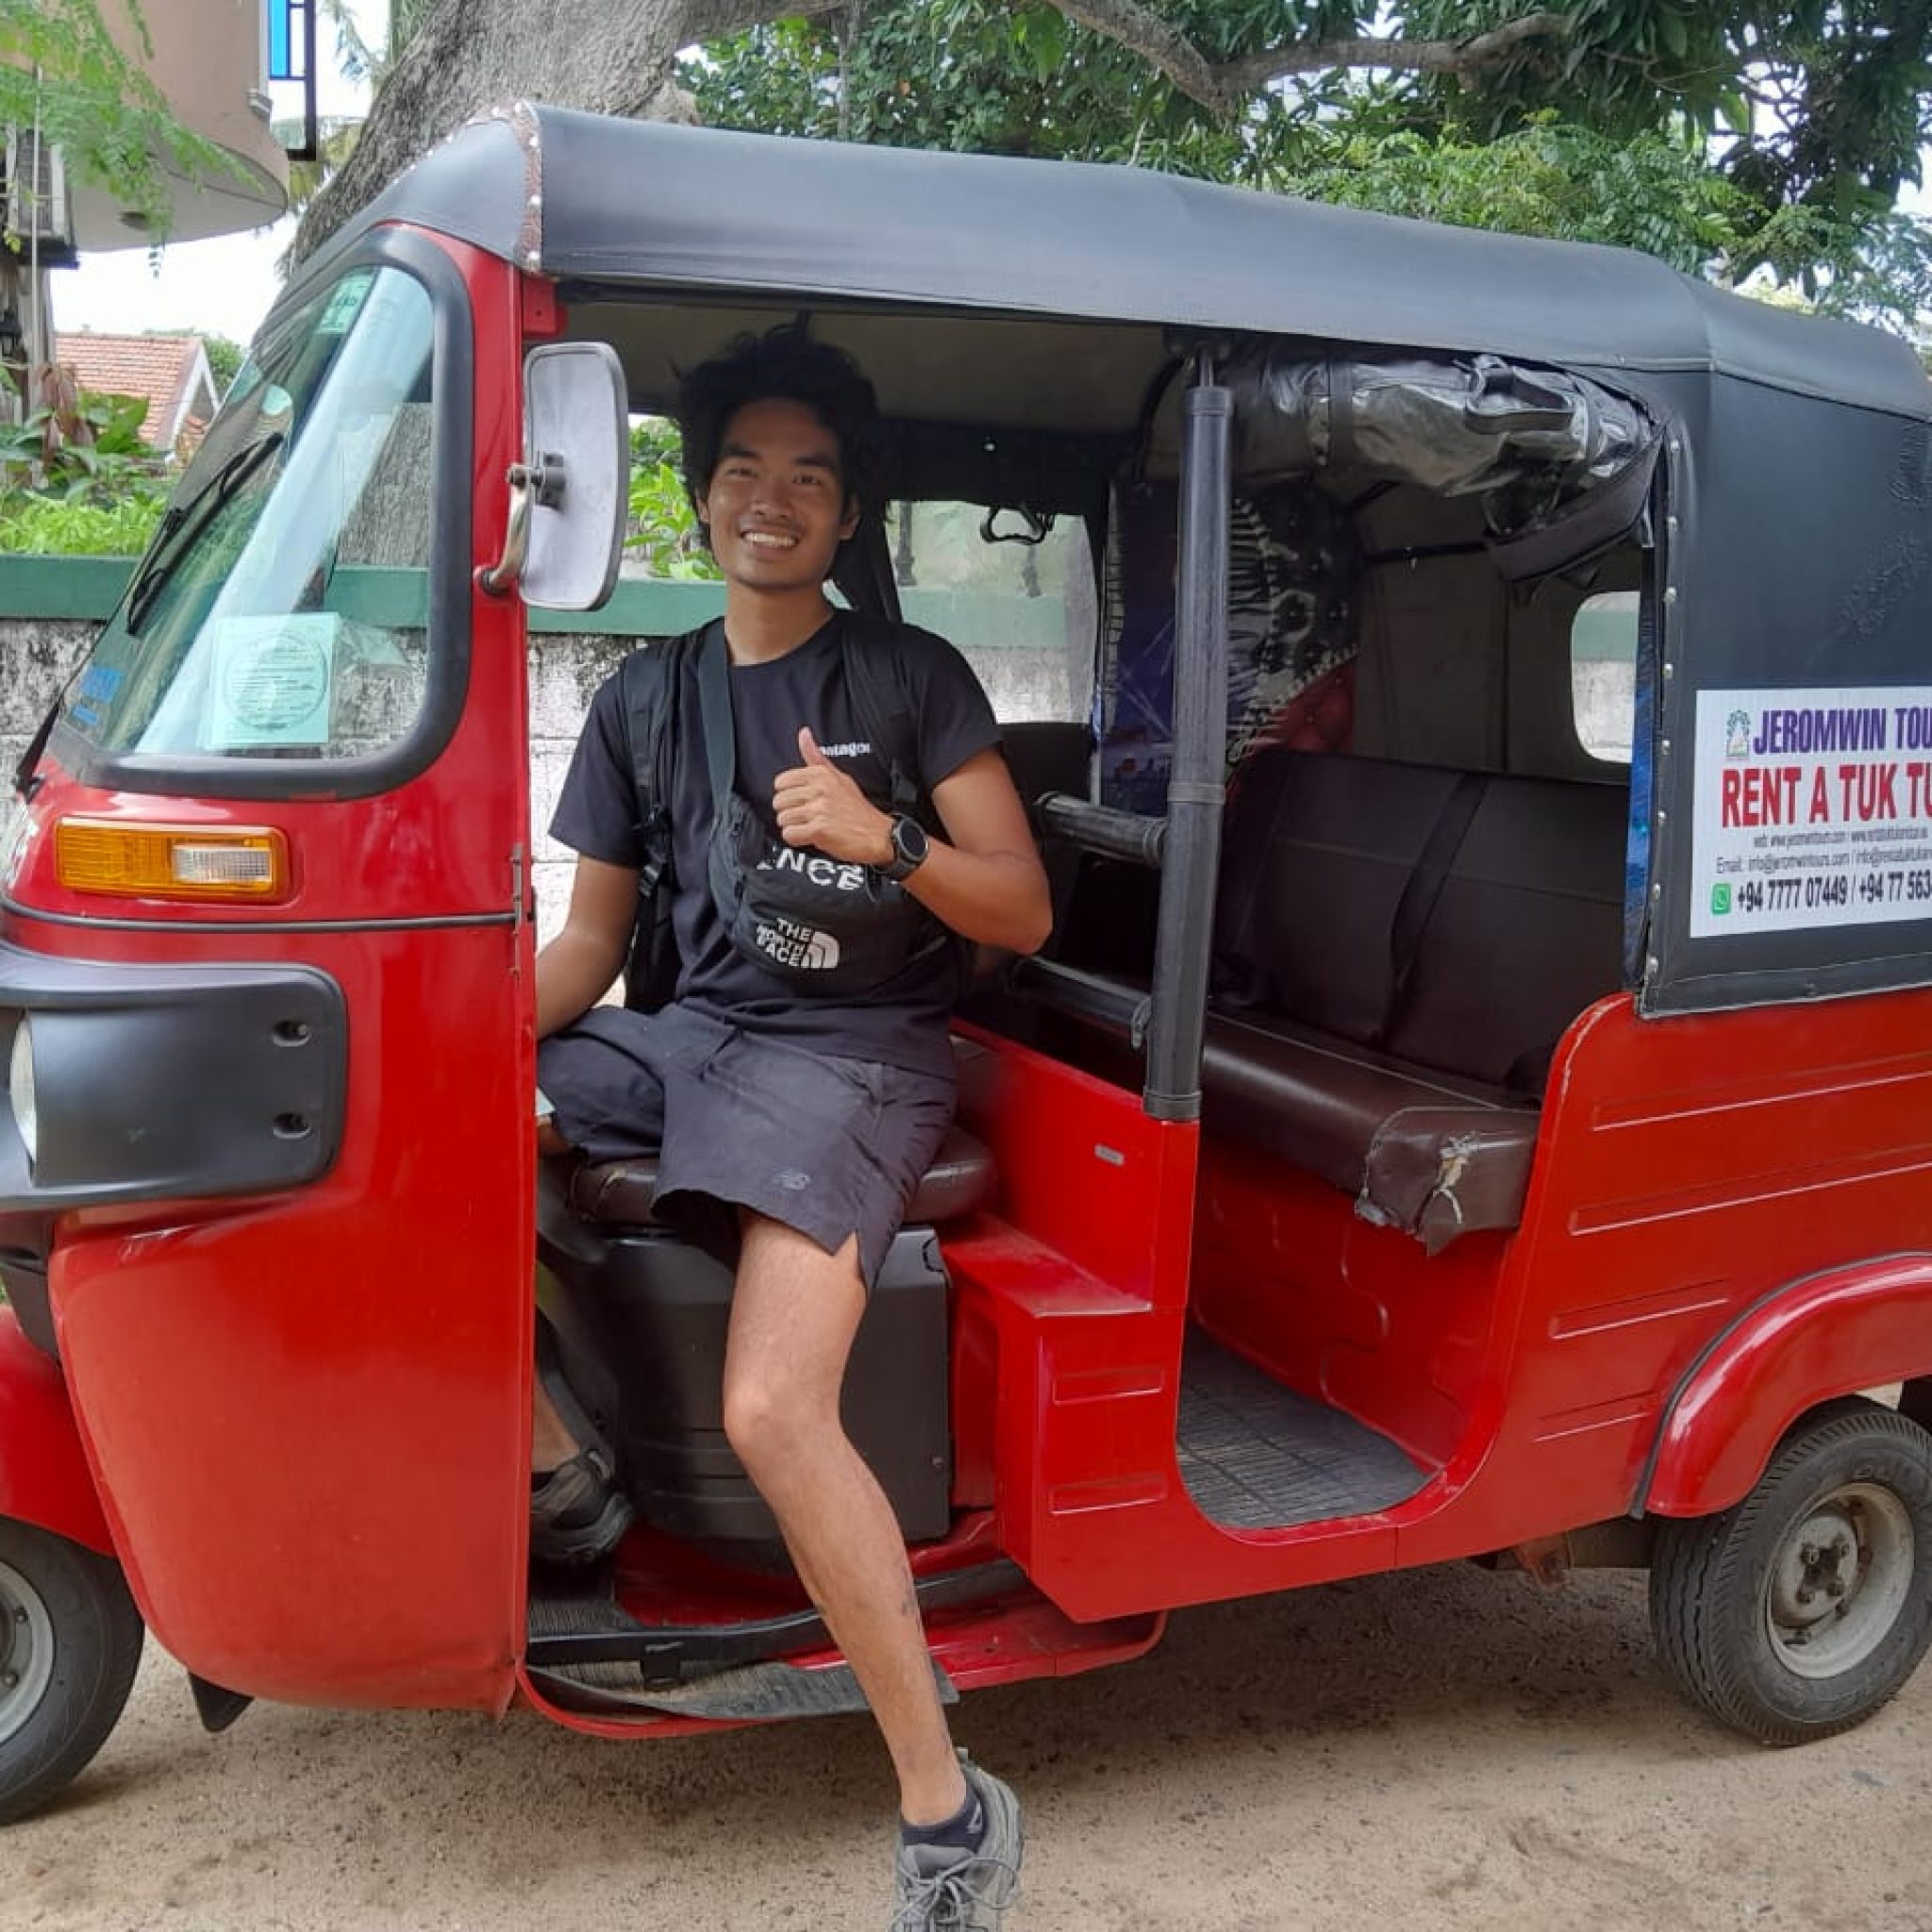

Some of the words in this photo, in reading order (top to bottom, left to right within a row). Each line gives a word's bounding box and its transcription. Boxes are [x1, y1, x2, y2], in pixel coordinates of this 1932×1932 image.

[1753, 708, 1887, 755] JEROMWIN
[1722, 767, 1802, 828] RENT
[1808, 766, 1829, 824] A
[1839, 763, 1898, 822] TUK
[1738, 881, 1764, 912] +94
[1768, 878, 1802, 910] 7777
[1807, 874, 1847, 908] 07449
[1859, 873, 1885, 903] +94
[1888, 871, 1905, 902] 77
[776, 917, 812, 942] THE
